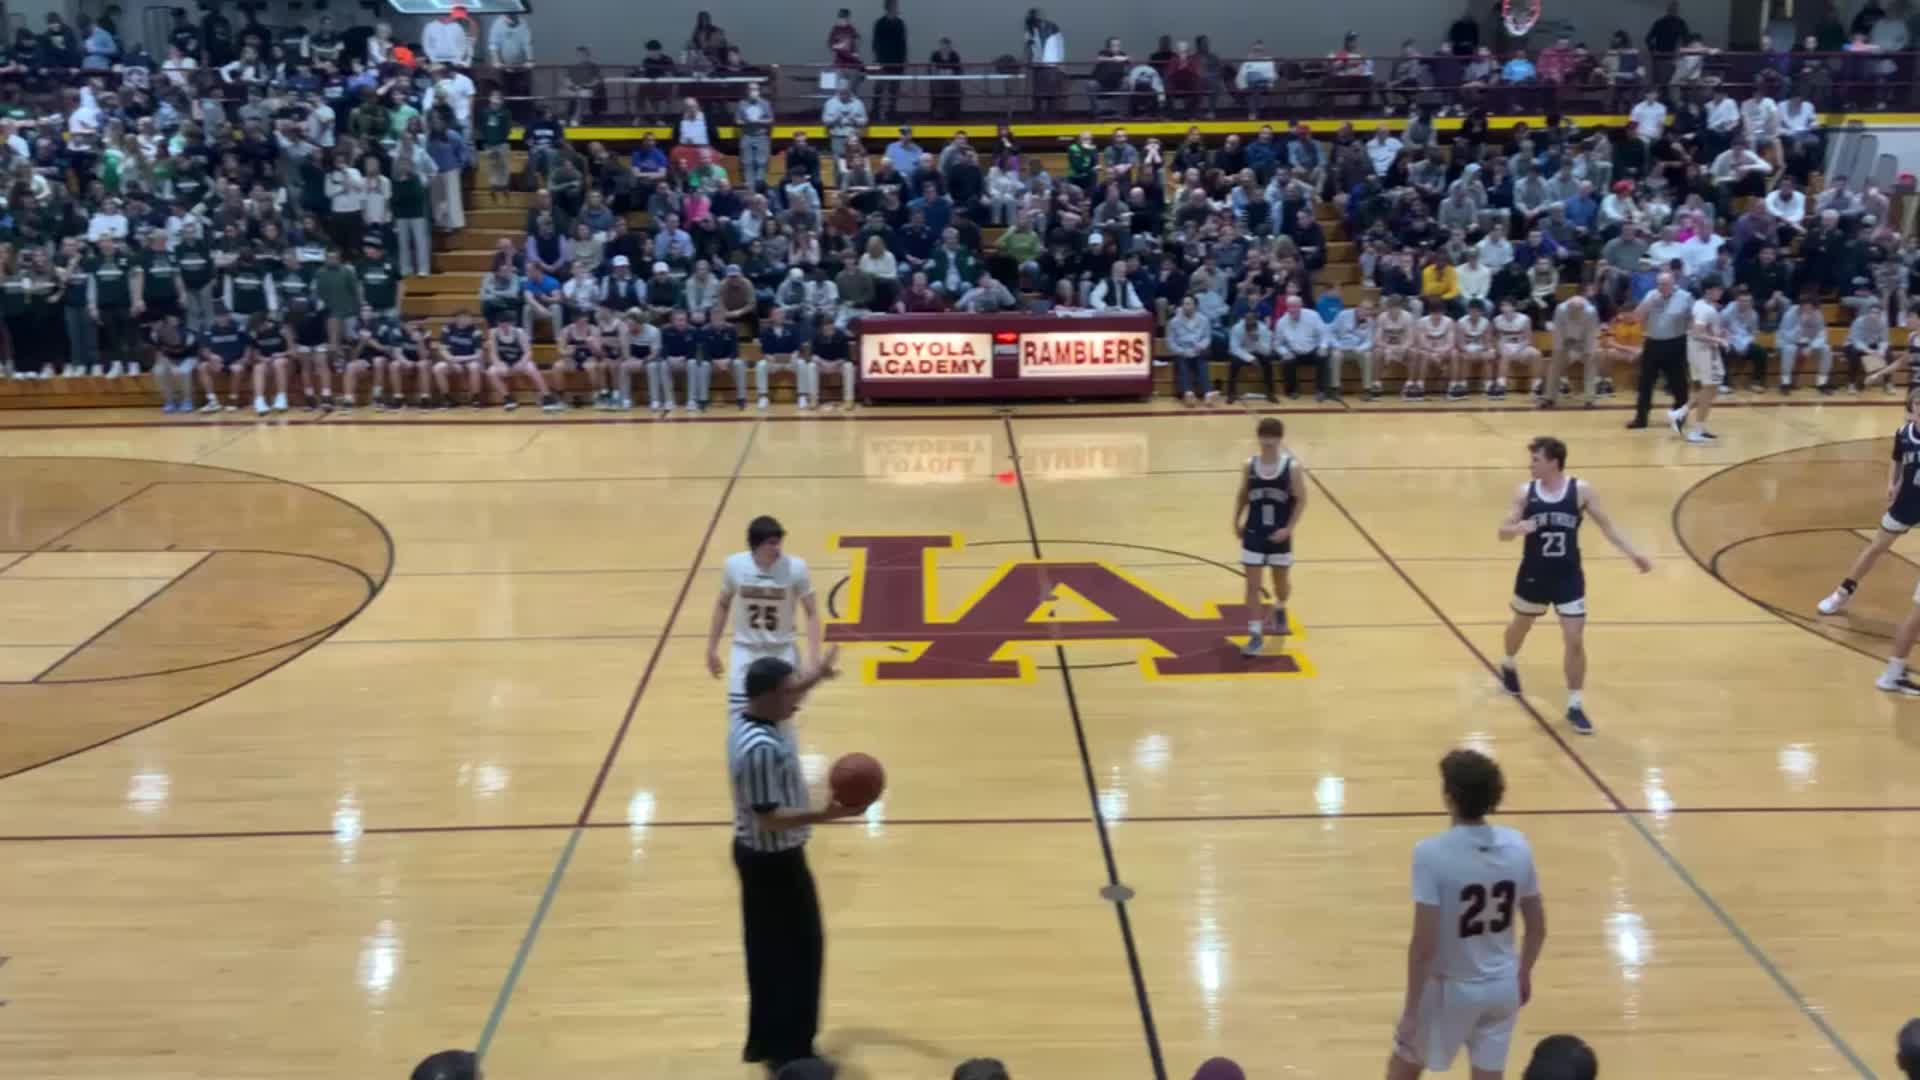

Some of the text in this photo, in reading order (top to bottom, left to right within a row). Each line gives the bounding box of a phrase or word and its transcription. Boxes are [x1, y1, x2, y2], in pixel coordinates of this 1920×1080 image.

[878, 341, 976, 357] LOYOLA
[1023, 337, 1146, 366] RAMBLERS
[868, 359, 987, 375] ACADEMY
[1540, 532, 1566, 557] 23
[748, 603, 777, 632] 25
[1458, 880, 1516, 938] 23
